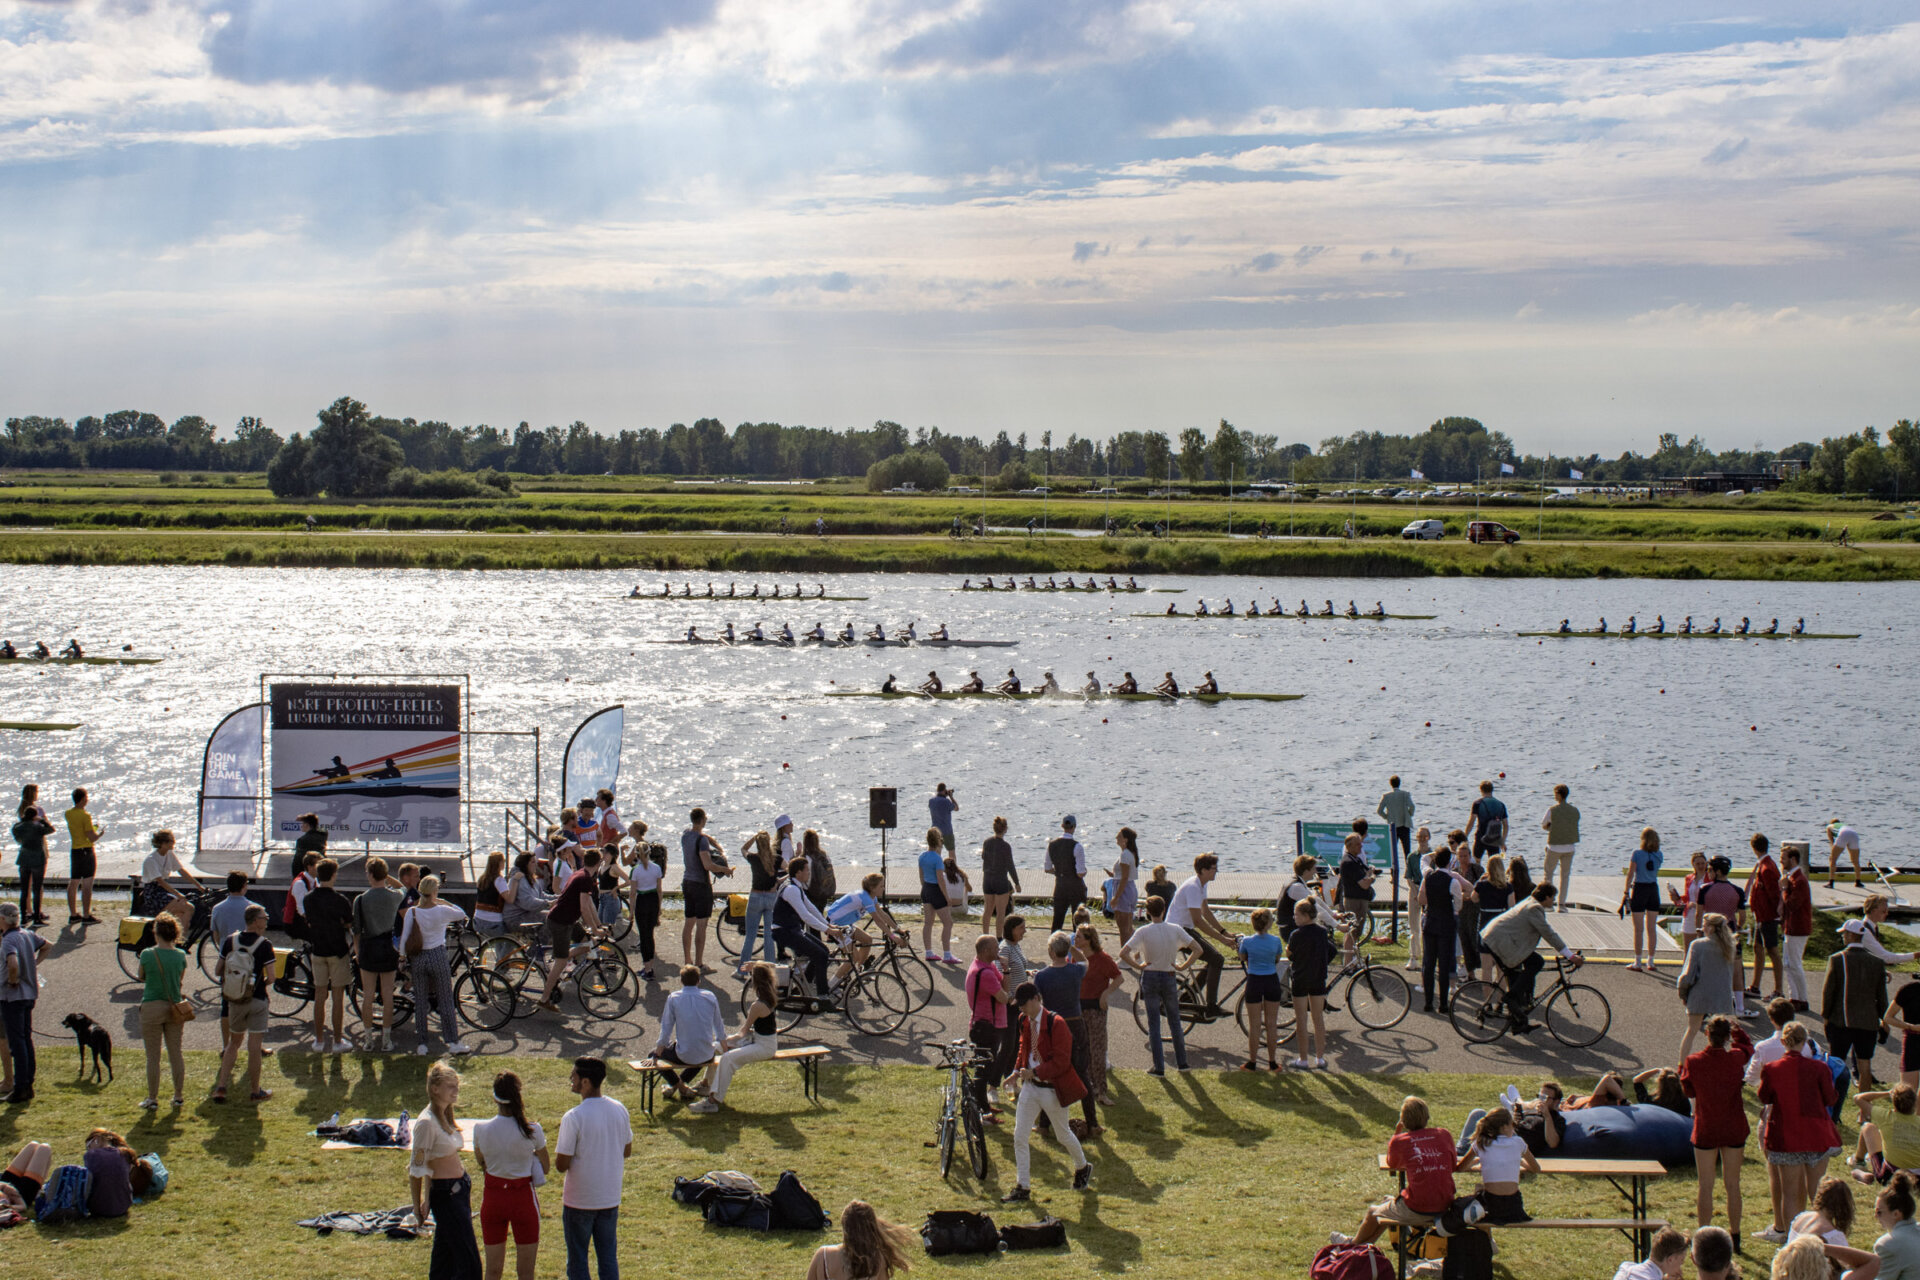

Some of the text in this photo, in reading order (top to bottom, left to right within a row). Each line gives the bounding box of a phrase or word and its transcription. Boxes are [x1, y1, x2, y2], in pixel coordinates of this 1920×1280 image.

[406, 691, 416, 699] op
[416, 690, 425, 698] de
[287, 699, 444, 712] NSRF PROTEUS-ERETES
[287, 713, 444, 725] LUSTRUM SLOTWEDSTRIJDEN
[208, 751, 236, 763] JOIN
[208, 760, 228, 770] THE
[208, 769, 244, 780] GAME.
[359, 819, 409, 834] ChipSoft
